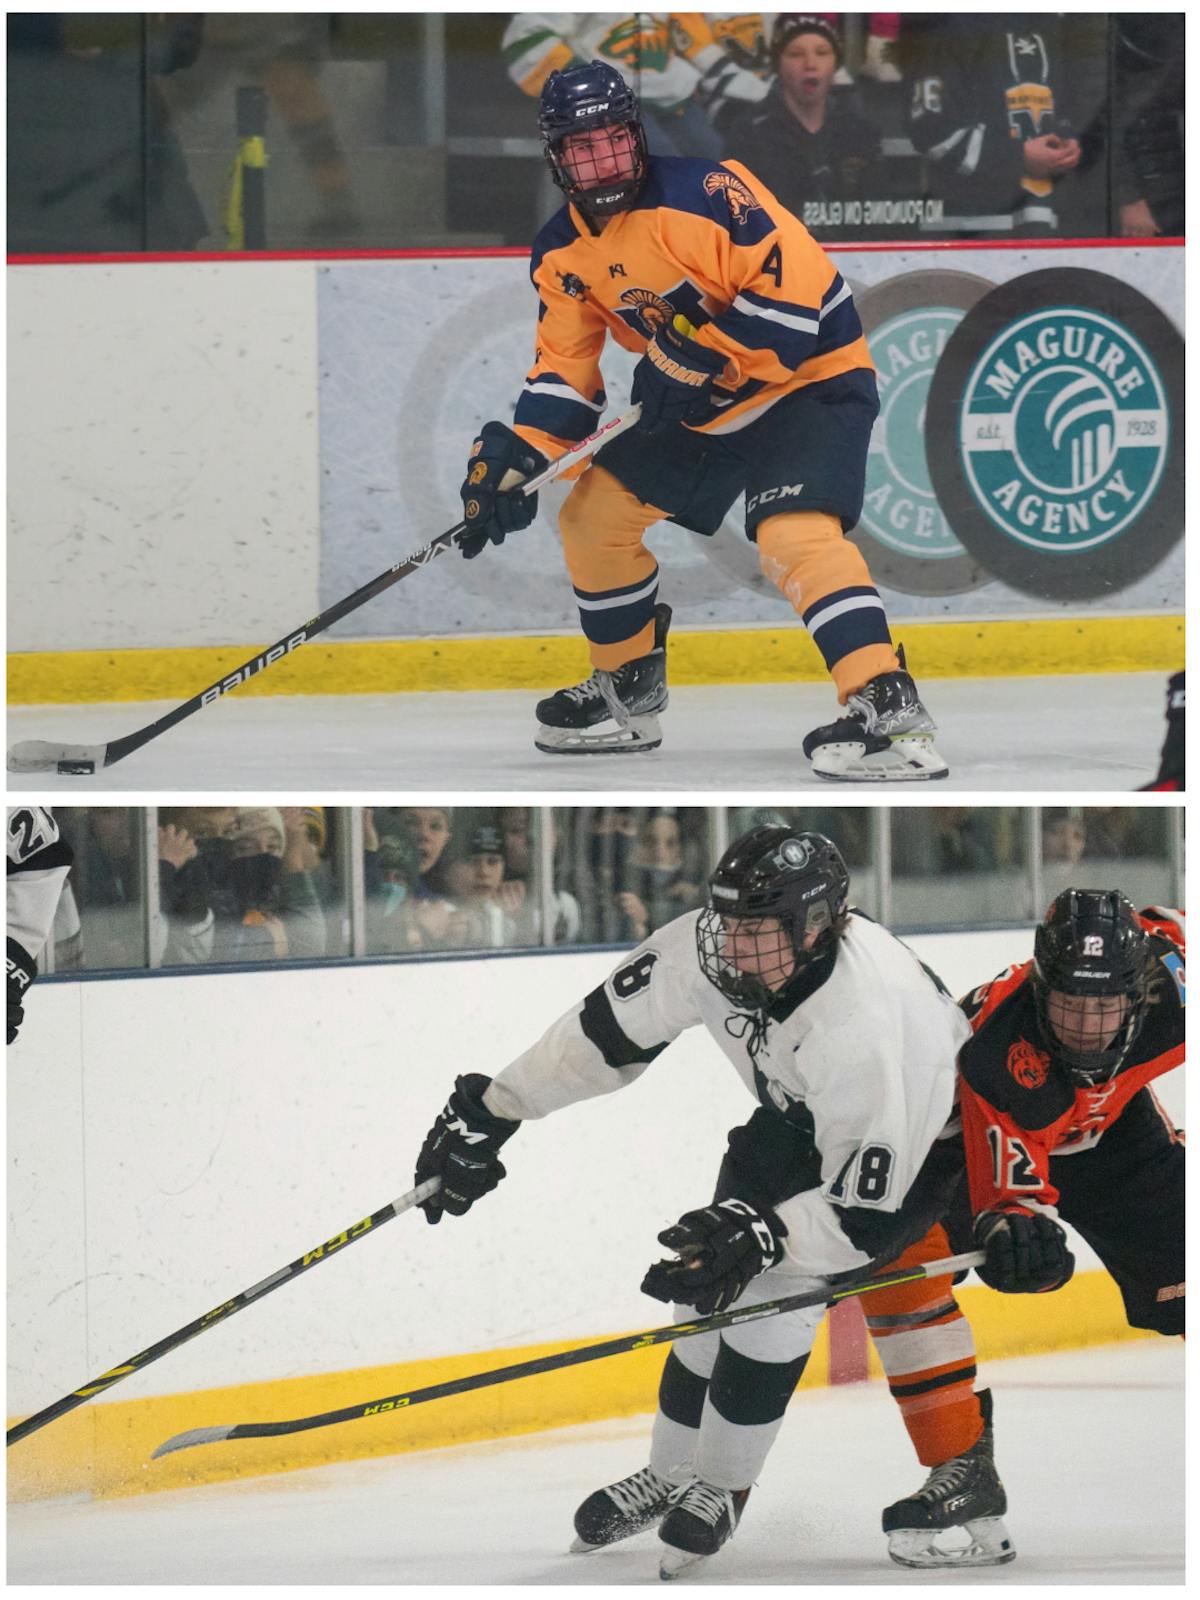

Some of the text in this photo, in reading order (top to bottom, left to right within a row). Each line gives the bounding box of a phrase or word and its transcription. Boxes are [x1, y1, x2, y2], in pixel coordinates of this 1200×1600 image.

[575, 102, 609, 117] CCM
[761, 242, 782, 288] 4
[984, 325, 1145, 400] MAGUIRE
[747, 483, 804, 514] CCM
[992, 469, 1135, 535] AGENCY
[1083, 936, 1104, 956] 12
[1073, 970, 1111, 979] BAUER
[826, 1142, 896, 1206] 18
[987, 1125, 1045, 1190] 12
[302, 1215, 373, 1267] CCM
[363, 1397, 410, 1416] CCM
